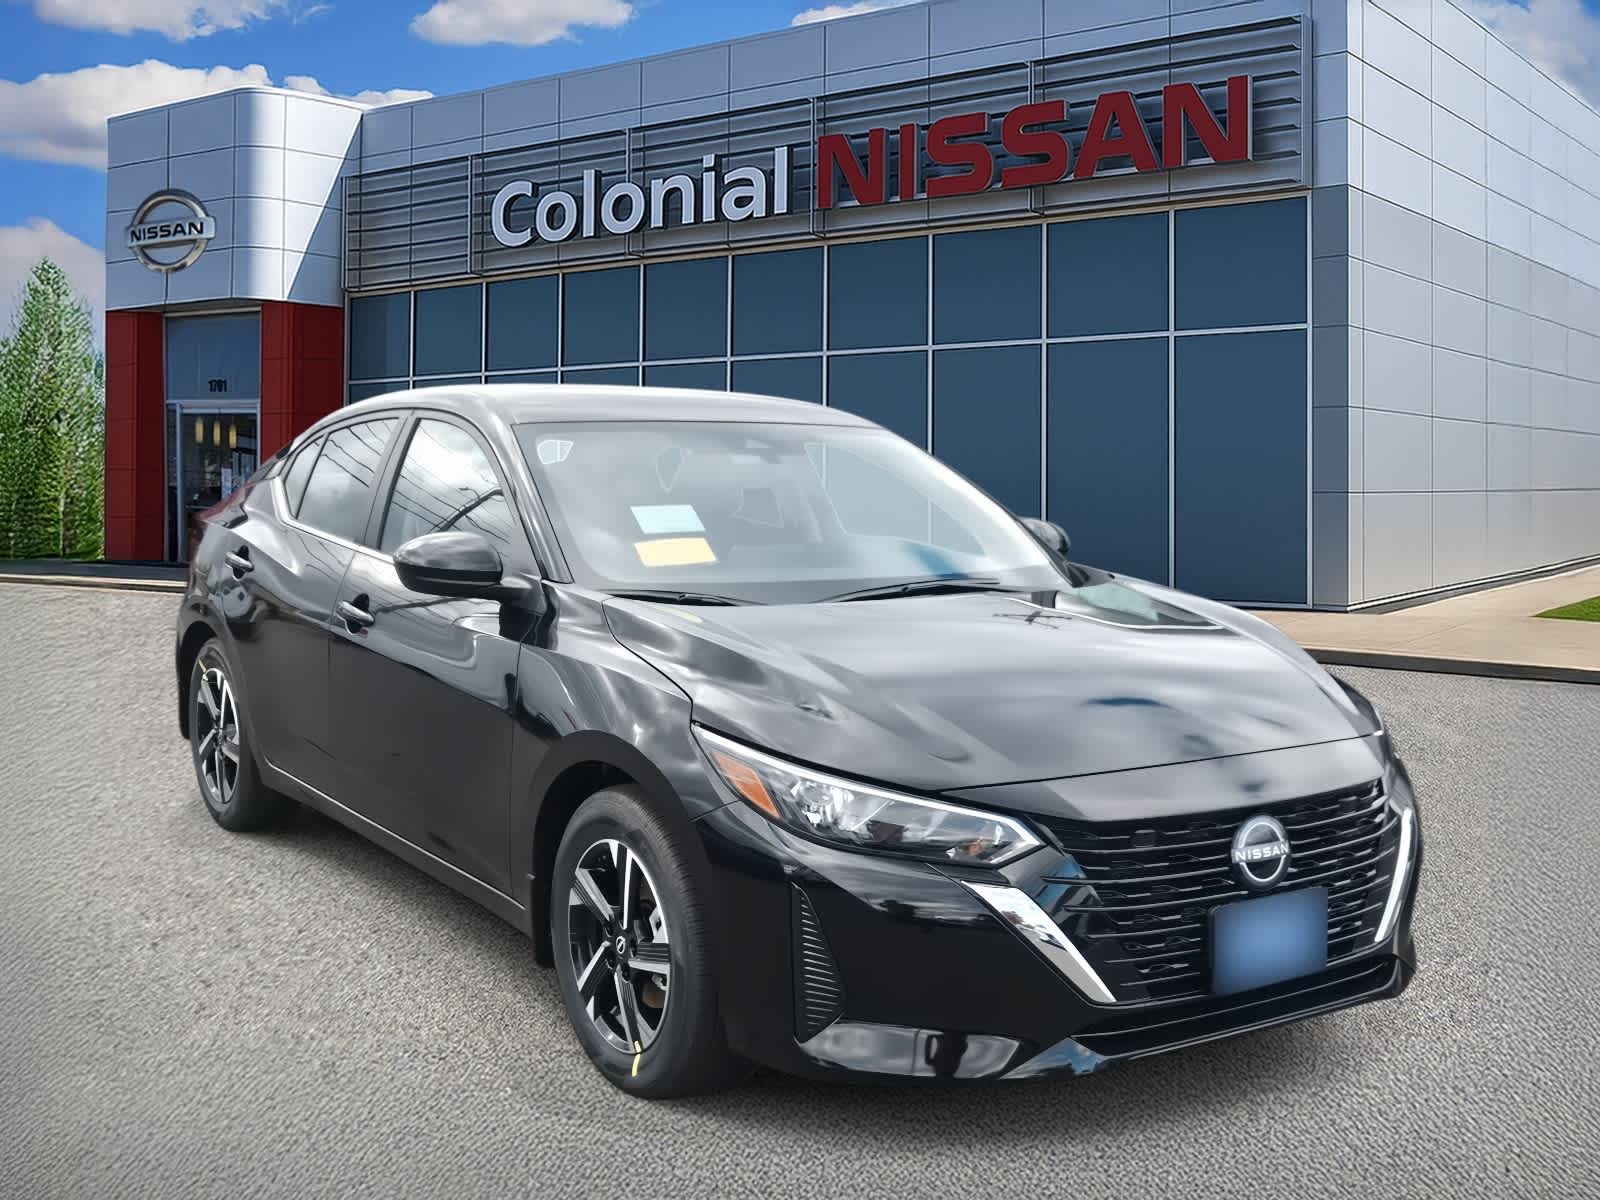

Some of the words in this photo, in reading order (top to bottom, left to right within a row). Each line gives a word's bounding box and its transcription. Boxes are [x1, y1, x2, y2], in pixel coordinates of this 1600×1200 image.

[490, 146, 790, 248] Colonial
[817, 75, 1252, 209] NISSAN
[129, 221, 205, 243] NISSAN
[1234, 843, 1289, 862] NISSAN
